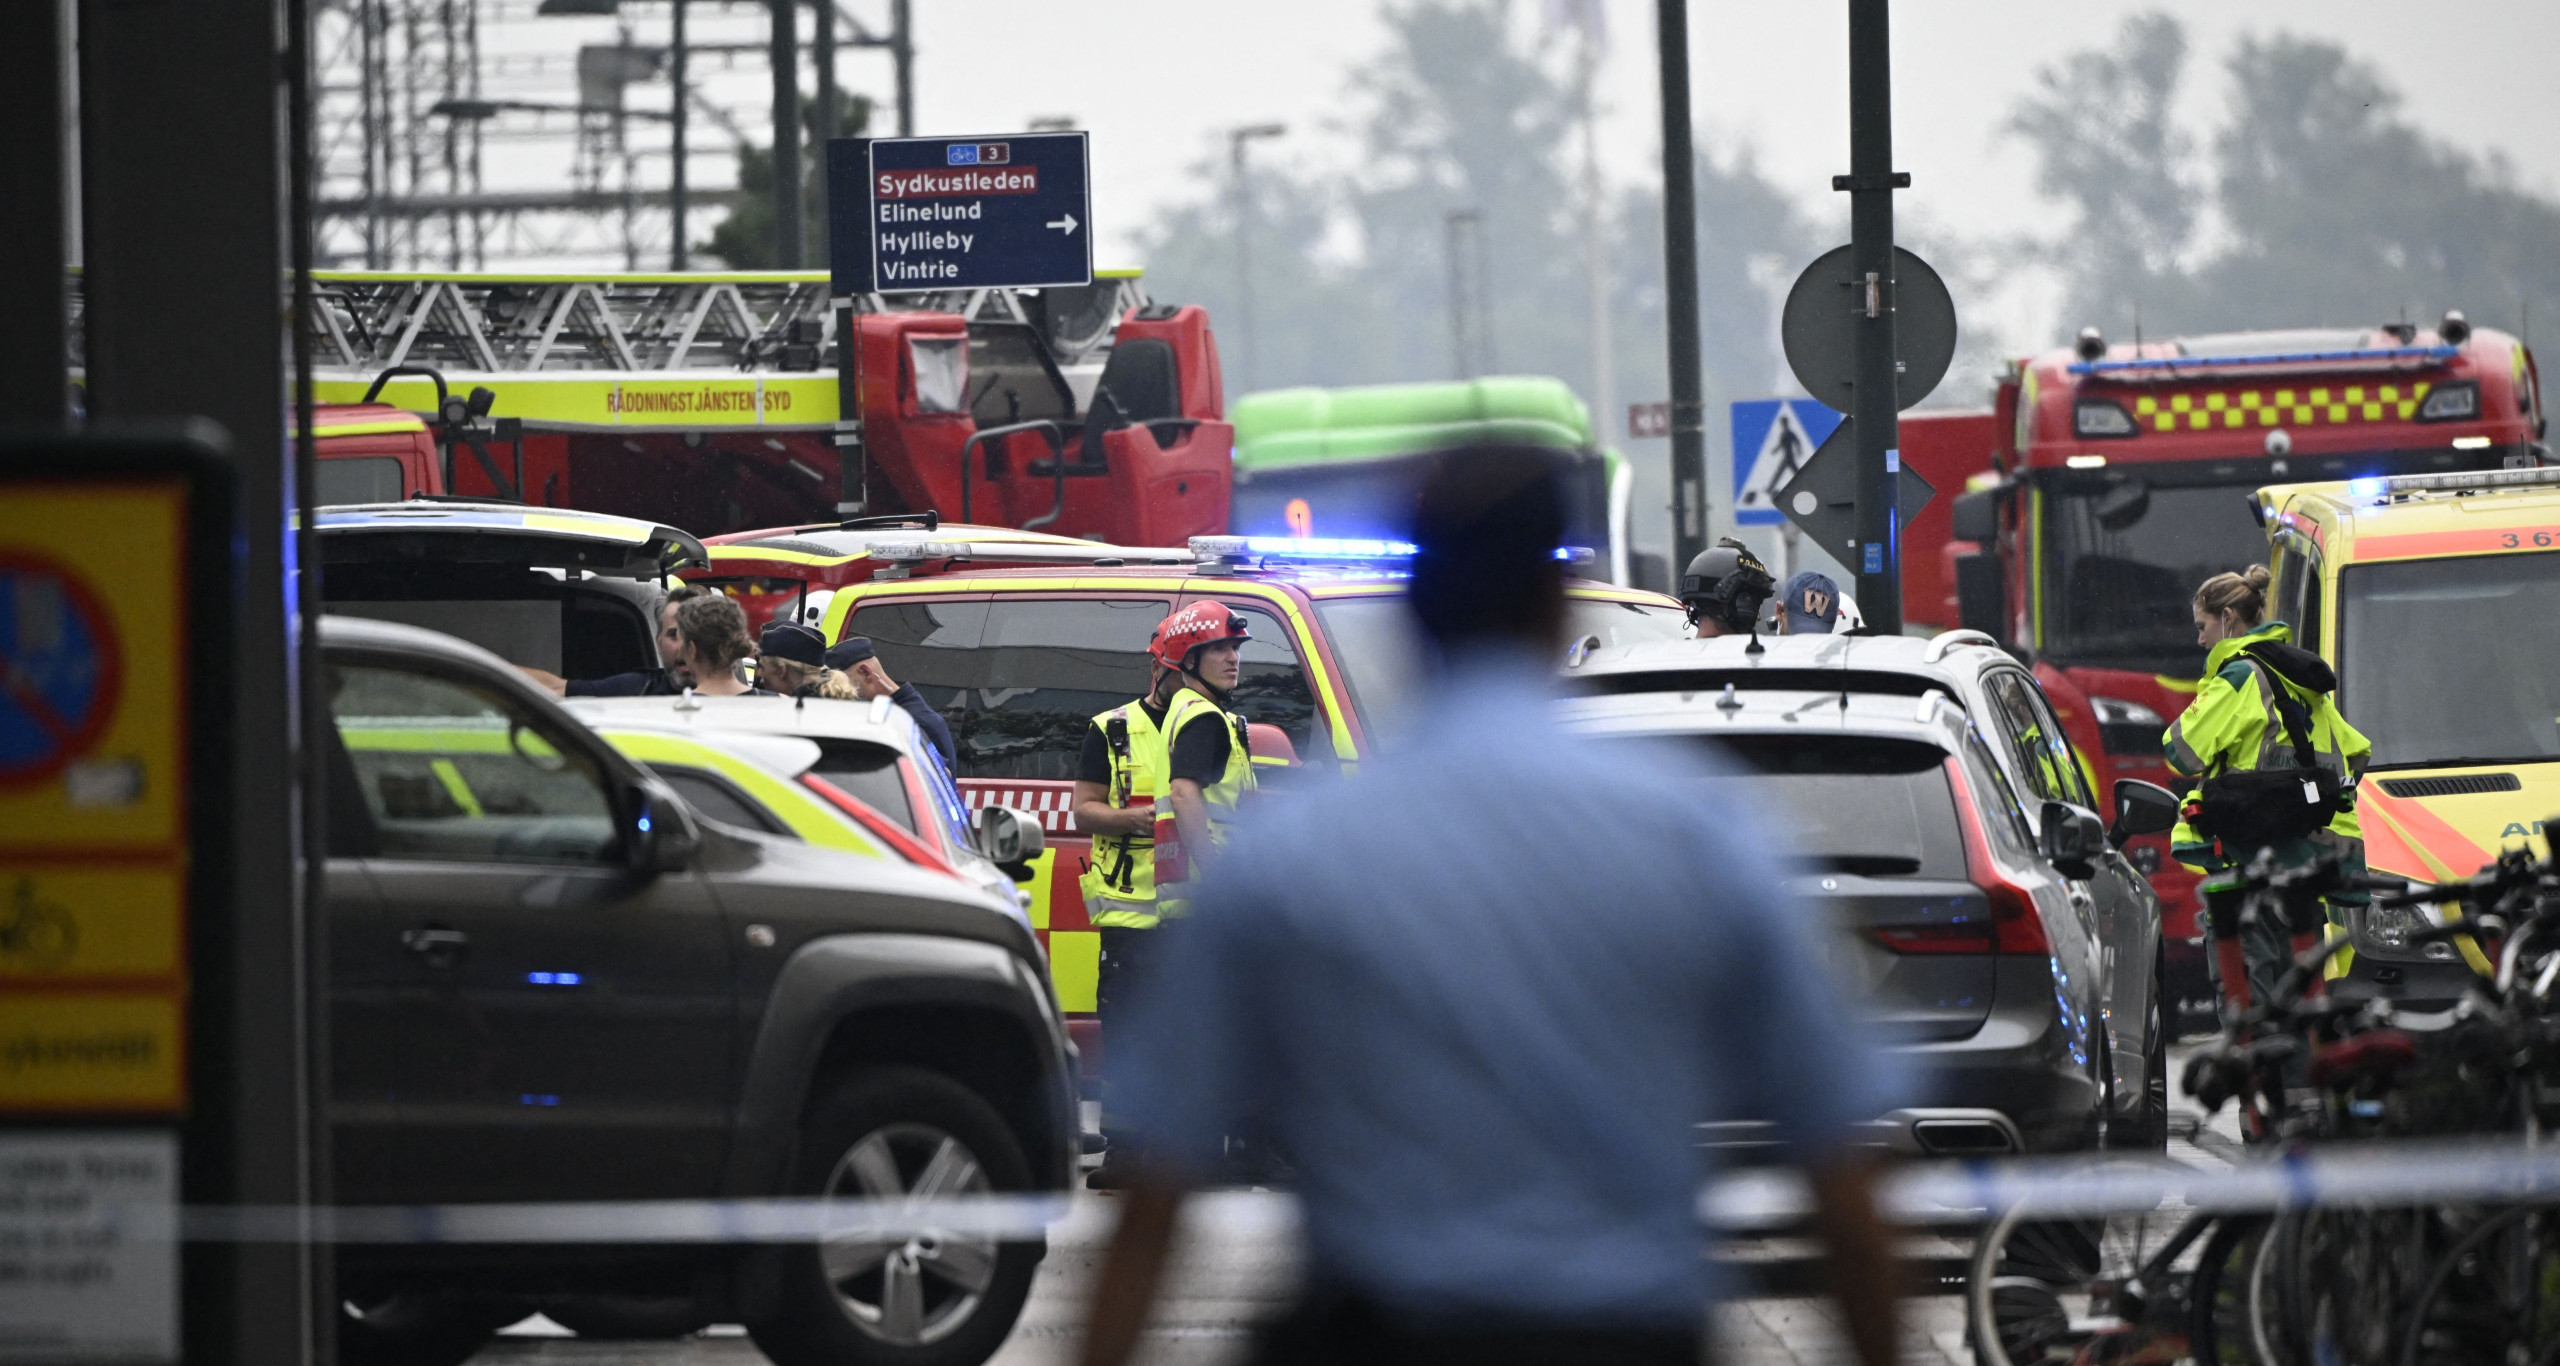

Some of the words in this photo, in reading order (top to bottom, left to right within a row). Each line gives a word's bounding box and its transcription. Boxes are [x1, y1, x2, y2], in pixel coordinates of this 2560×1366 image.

[989, 148, 998, 160] 3
[879, 172, 1035, 198] Sydkustleden
[880, 201, 982, 223] Elinelund
[881, 231, 974, 256] Hyllieby
[883, 260, 959, 280] Vintrie
[764, 390, 792, 412] SYD
[2501, 533, 2520, 548] 3
[2532, 531, 2560, 547] 6
[1804, 588, 1831, 618] W
